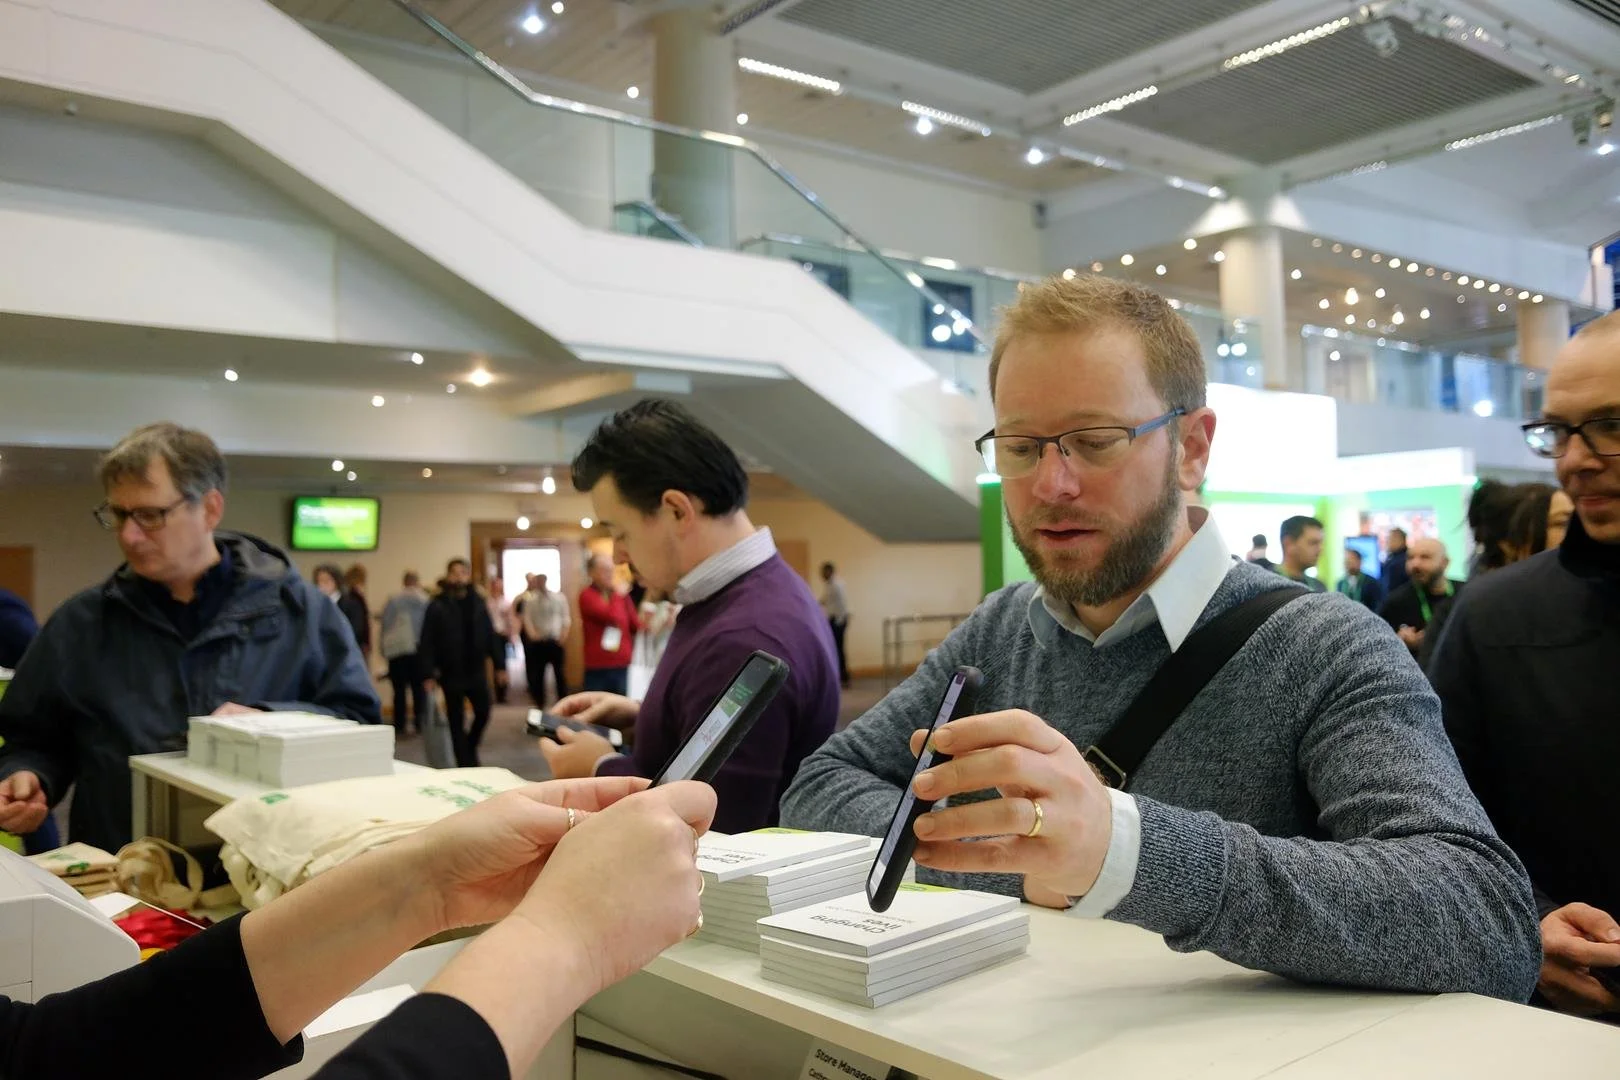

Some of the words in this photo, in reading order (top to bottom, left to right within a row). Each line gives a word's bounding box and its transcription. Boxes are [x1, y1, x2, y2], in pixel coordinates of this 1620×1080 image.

[809, 915, 886, 934] Changing
[861, 918, 903, 930] lives
[815, 1048, 838, 1067] Store
